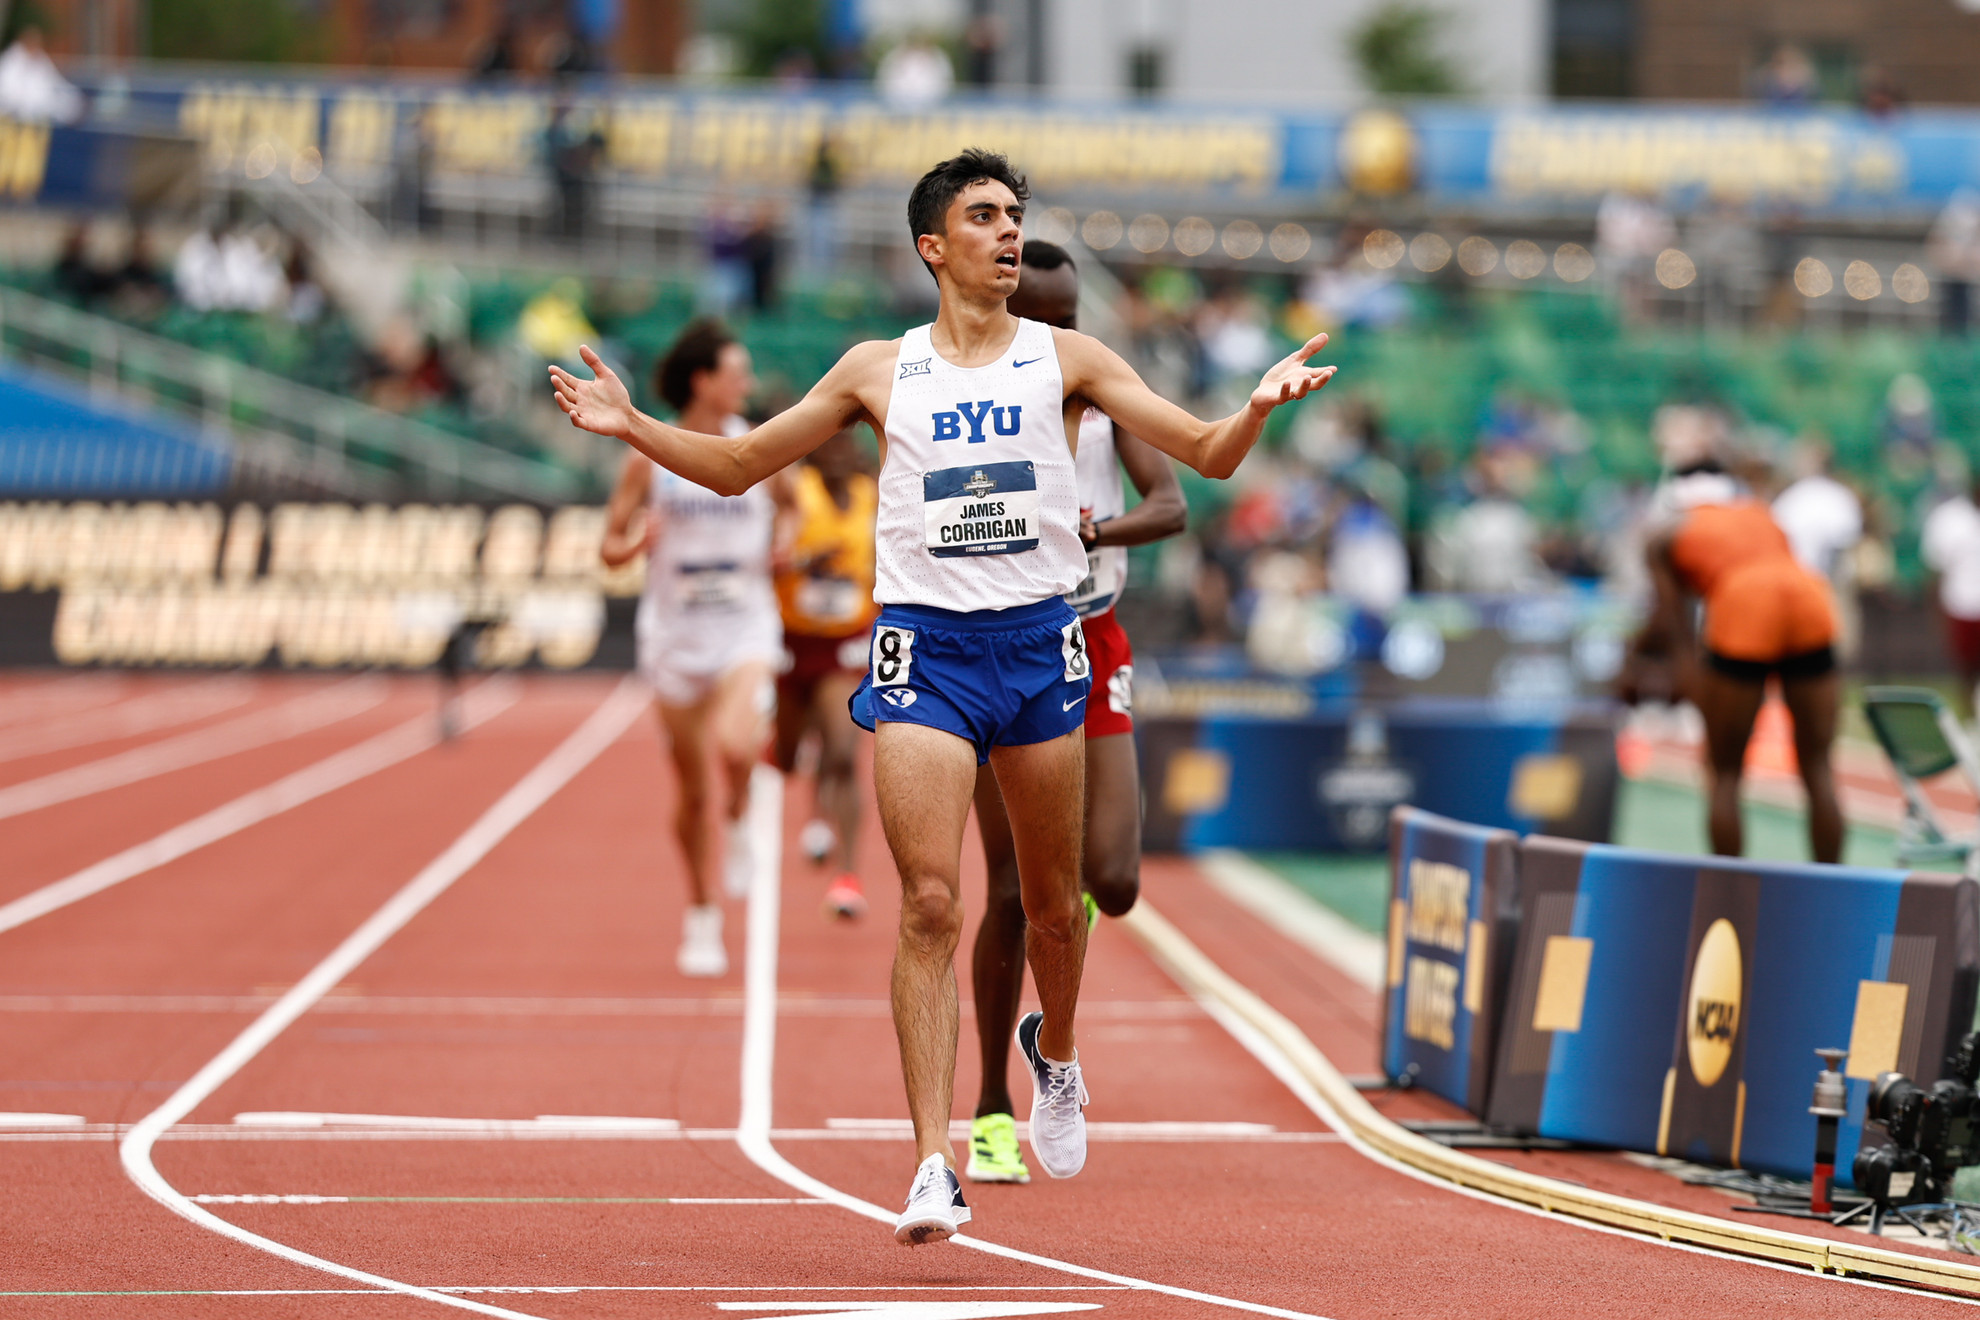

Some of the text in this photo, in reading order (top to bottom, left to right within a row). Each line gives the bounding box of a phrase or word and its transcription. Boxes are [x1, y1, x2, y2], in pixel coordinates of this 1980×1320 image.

[932, 400, 1021, 443] BYU
[960, 501, 1005, 519] JAMES
[940, 518, 1027, 543] CORRIGAN
[986, 543, 1007, 552] OREGON
[878, 630, 902, 682] 8
[1070, 625, 1086, 676] 8
